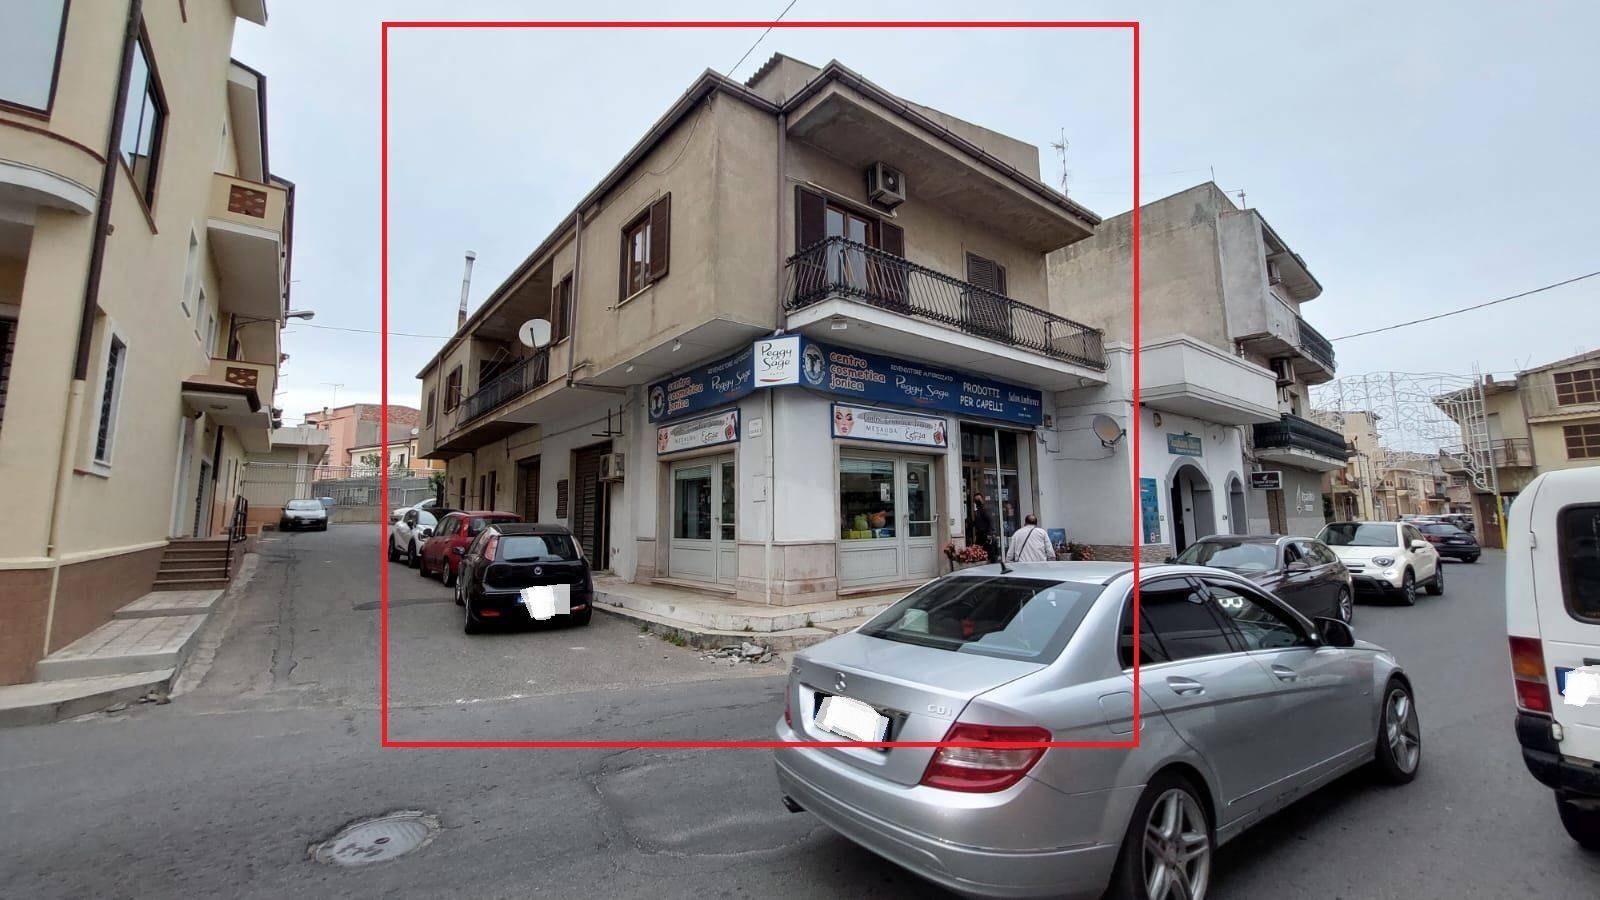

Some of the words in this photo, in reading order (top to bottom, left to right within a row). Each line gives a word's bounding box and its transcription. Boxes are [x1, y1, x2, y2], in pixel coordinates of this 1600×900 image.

[761, 342, 792, 360] Peggy
[830, 352, 867, 368] centro
[761, 358, 791, 372] Sage
[830, 364, 886, 383] cosmetica
[830, 373, 864, 391] jonica
[895, 374, 923, 398] Peggy
[925, 384, 949, 400] Sage
[963, 381, 1000, 399] PRODOTTI
[960, 395, 974, 408] PER
[976, 398, 1004, 412] CAPELLI
